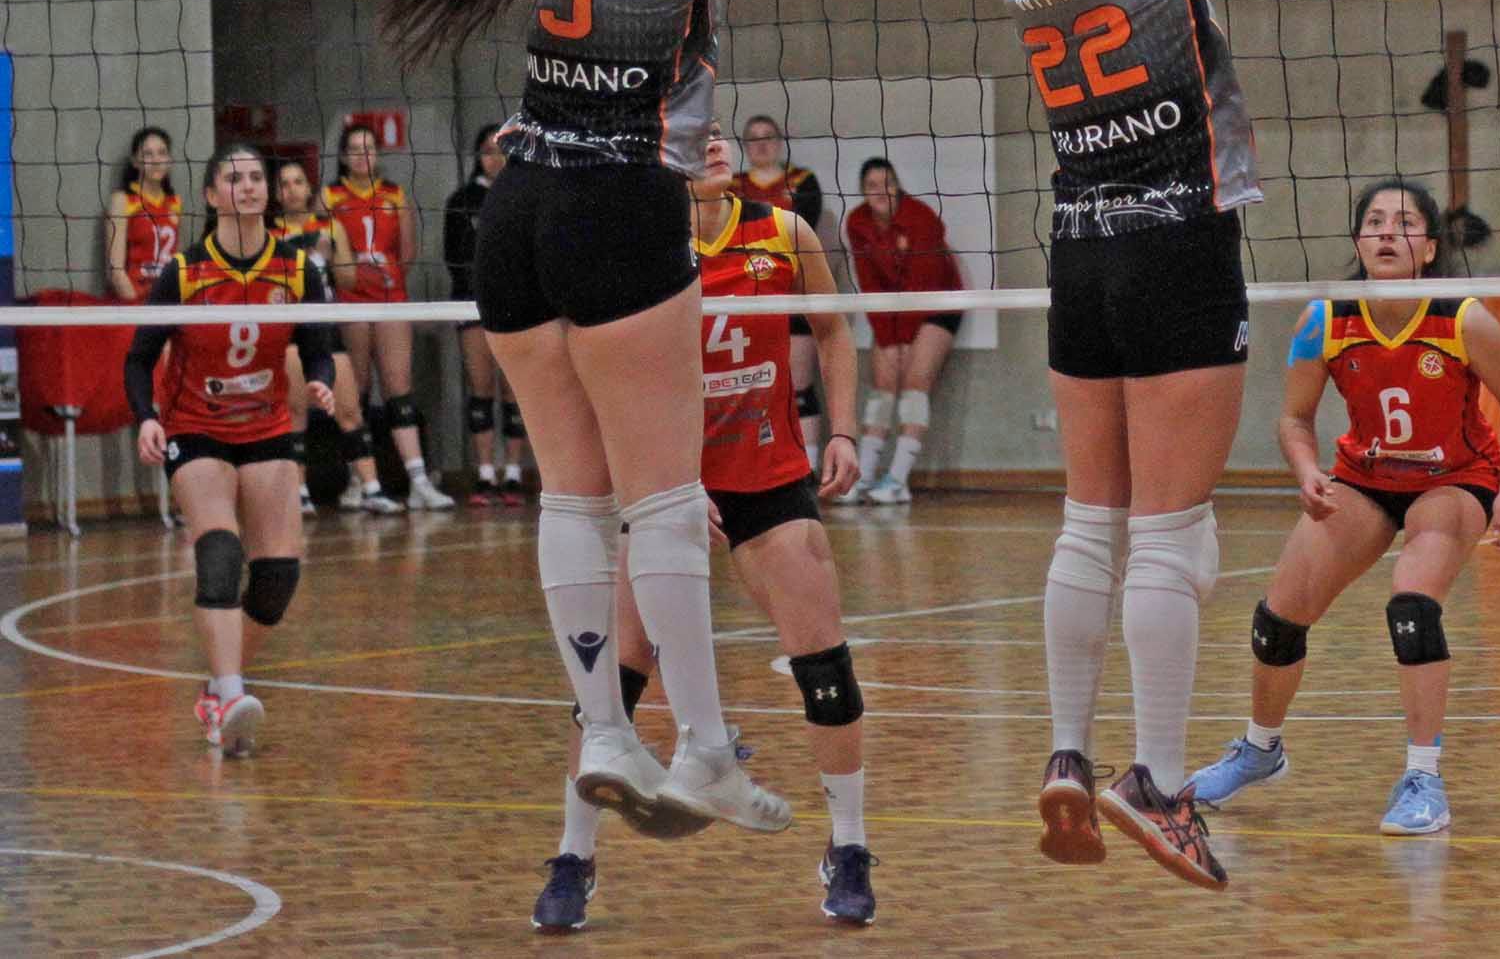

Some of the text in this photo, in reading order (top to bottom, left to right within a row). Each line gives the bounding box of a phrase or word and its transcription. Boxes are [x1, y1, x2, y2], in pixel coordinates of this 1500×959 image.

[1023, 3, 1149, 109] 22
[226, 321, 260, 368] 8
[1379, 387, 1413, 444] 6
